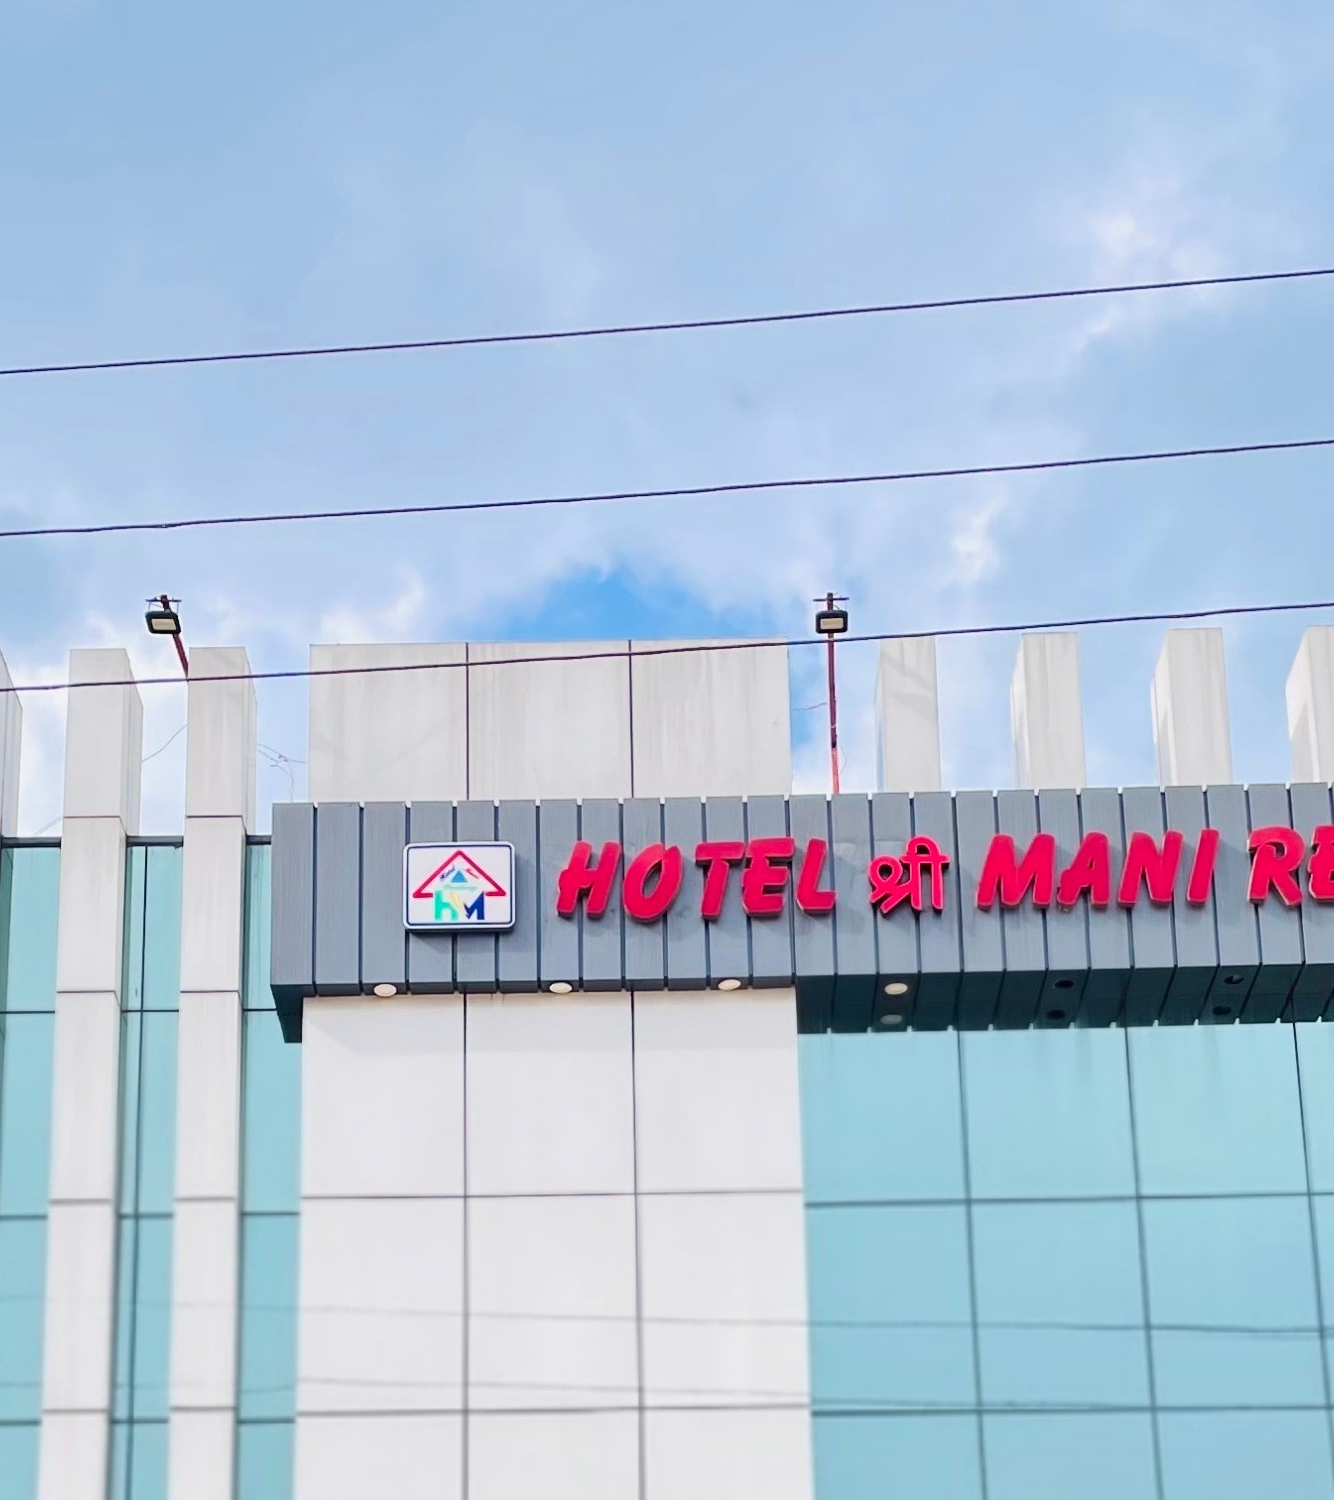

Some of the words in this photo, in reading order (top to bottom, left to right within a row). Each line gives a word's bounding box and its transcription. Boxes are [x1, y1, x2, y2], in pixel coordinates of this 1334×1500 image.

[557, 837, 837, 922] HOTEL
[868, 835, 951, 914] श्री
[976, 828, 1220, 911] MANI
